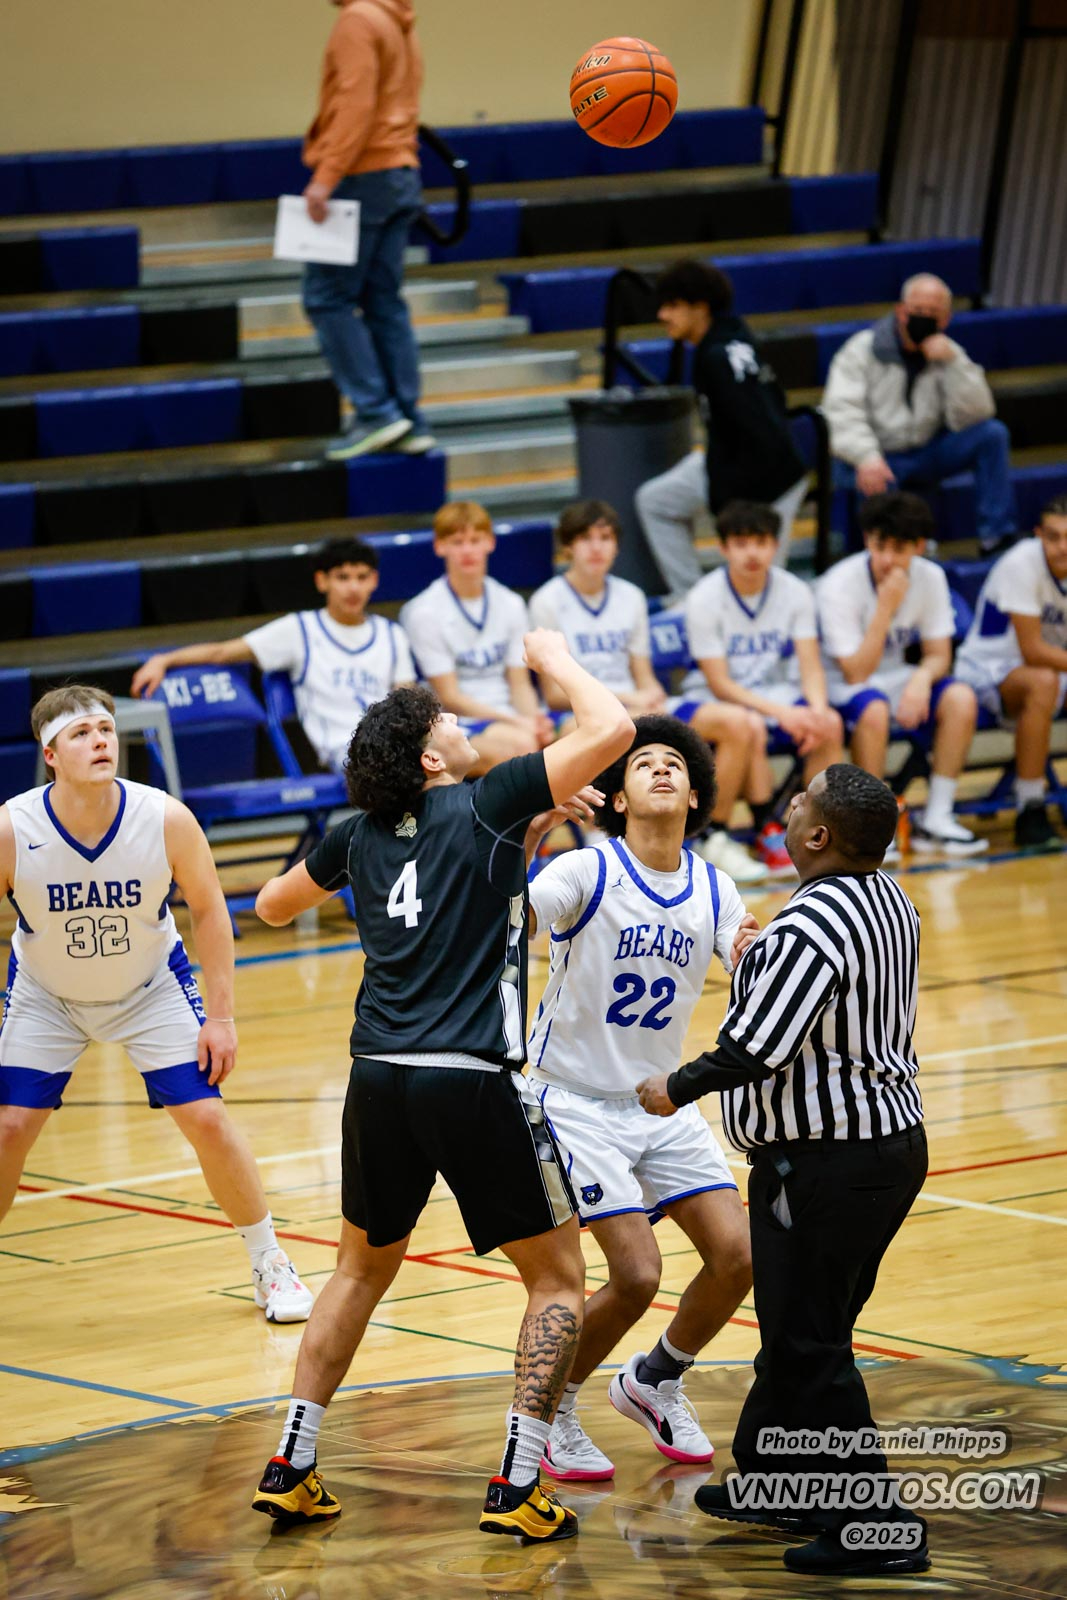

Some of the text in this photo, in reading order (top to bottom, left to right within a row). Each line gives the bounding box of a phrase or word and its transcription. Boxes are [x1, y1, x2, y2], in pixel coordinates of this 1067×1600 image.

[571, 53, 612, 81] den
[573, 86, 608, 118] ELITE
[47, 879, 142, 912] BEARS
[386, 859, 423, 928] 4
[65, 915, 130, 958] 32
[614, 924, 695, 967] BEARS
[606, 972, 677, 1031] 22
